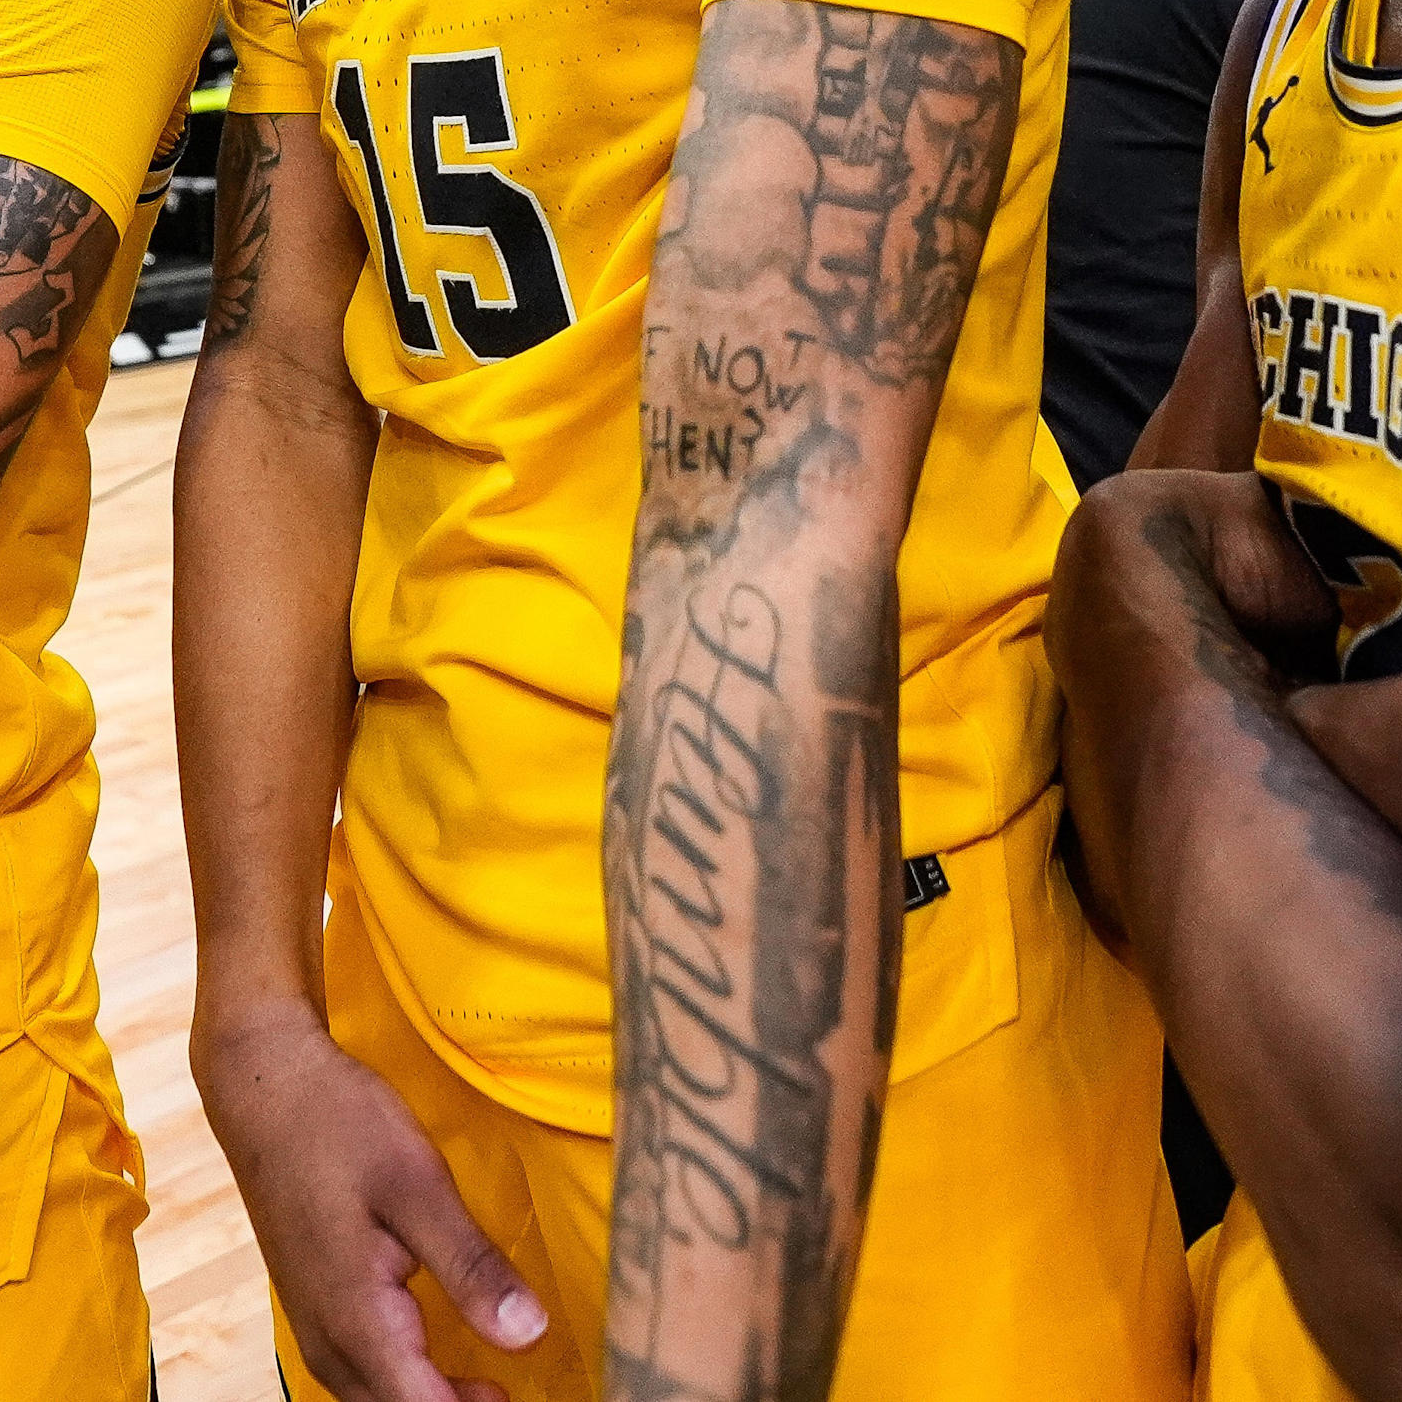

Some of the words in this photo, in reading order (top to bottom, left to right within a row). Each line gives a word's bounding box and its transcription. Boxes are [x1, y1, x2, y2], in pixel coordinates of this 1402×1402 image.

[330, 46, 578, 365] 15
[640, 402, 767, 484] HEN?
[649, 583, 812, 1251] Humble
